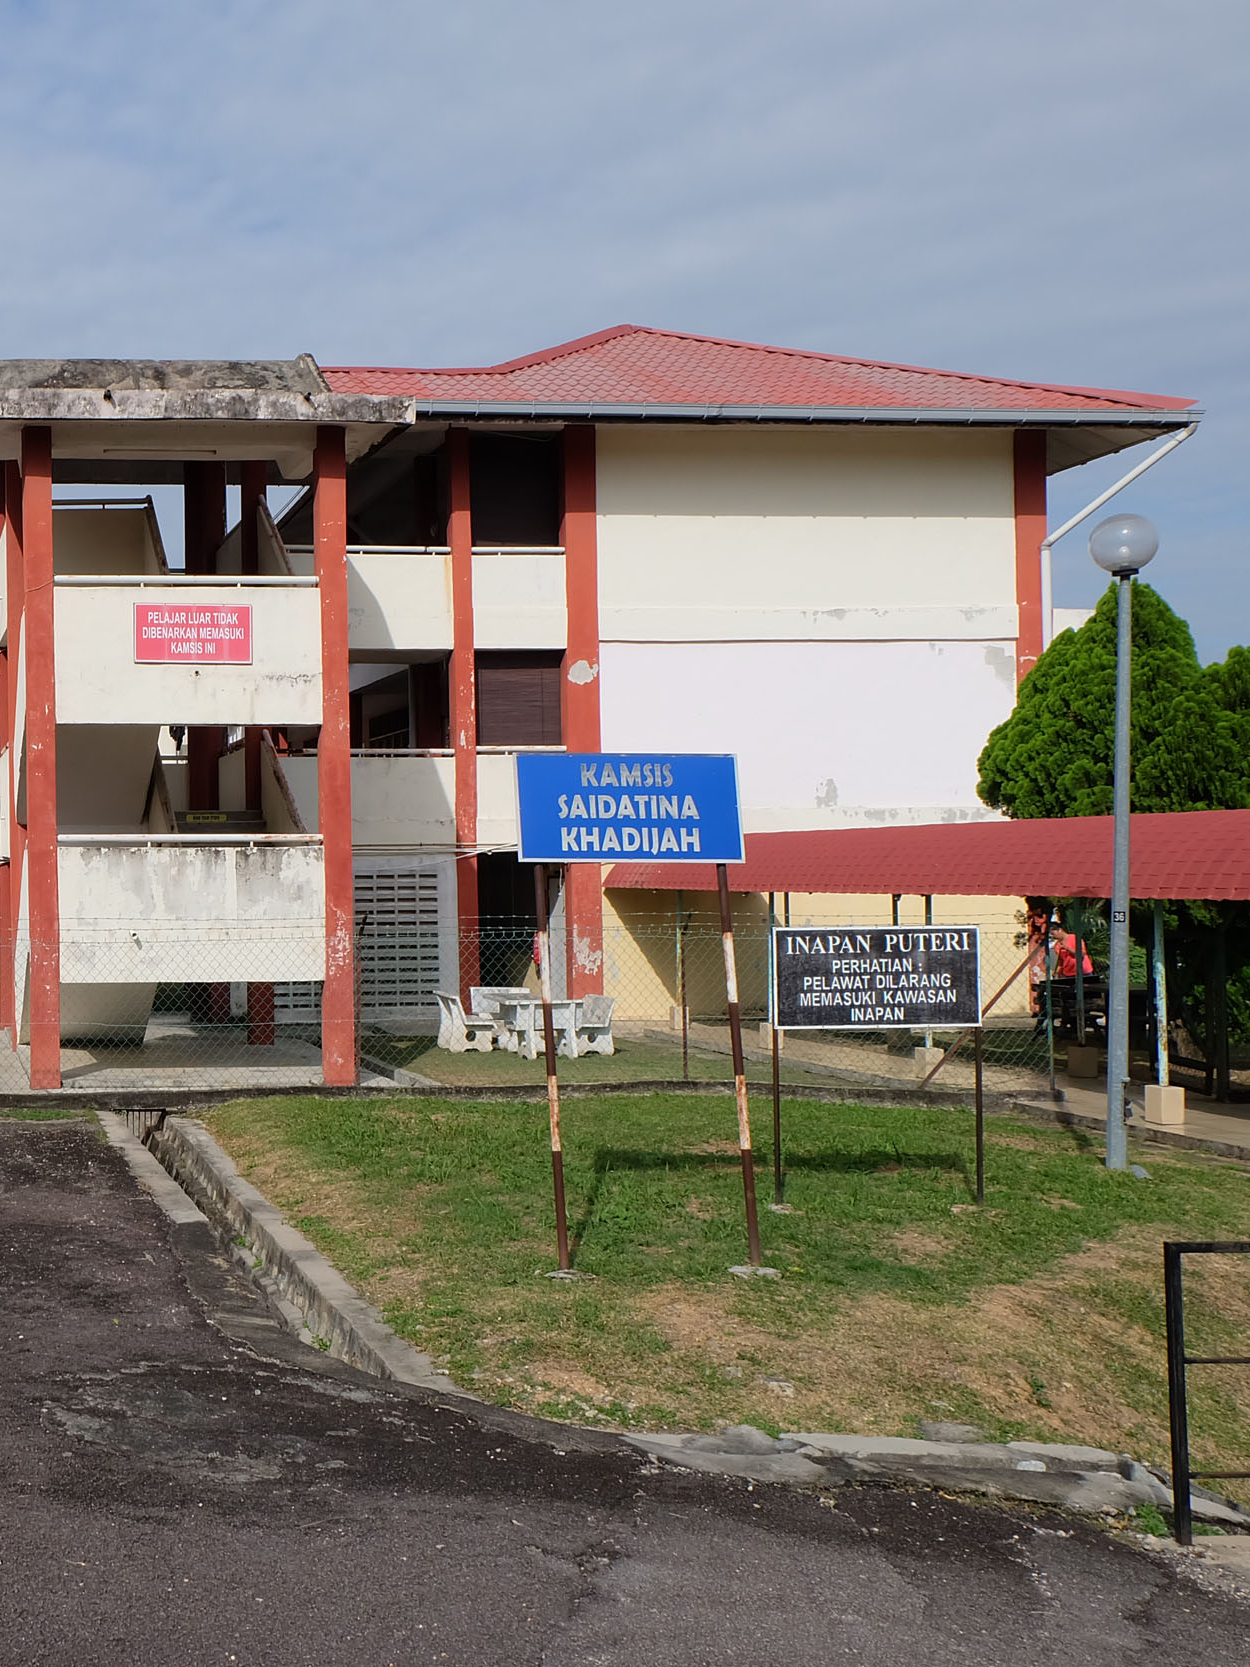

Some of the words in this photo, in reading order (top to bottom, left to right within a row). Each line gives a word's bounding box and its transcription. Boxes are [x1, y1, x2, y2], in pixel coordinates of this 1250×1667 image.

[148, 612, 186, 624] PELAJAR
[189, 612, 211, 624] LUAR
[213, 613, 238, 624] TIDAK
[142, 627, 197, 639] DIBENARKAN
[200, 628, 244, 639] MEMASUKI
[171, 642, 203, 654] KAMSIS
[205, 642, 216, 654] INI
[580, 763, 673, 787] KAMSIS
[558, 794, 700, 819] SAIDATINA
[561, 827, 700, 855] KHADIJAH
[1114, 912, 1125, 921] 36
[786, 935, 872, 955] INAPAN
[885, 932, 970, 952] PUTERI
[832, 959, 912, 973] PERHATIAN
[803, 975, 870, 990] PELAWAT
[876, 973, 951, 988] DILARANG
[800, 991, 876, 1006] MEMASUKI
[883, 989, 956, 1004] KAWASAN
[851, 1007, 905, 1021] INAPAN
